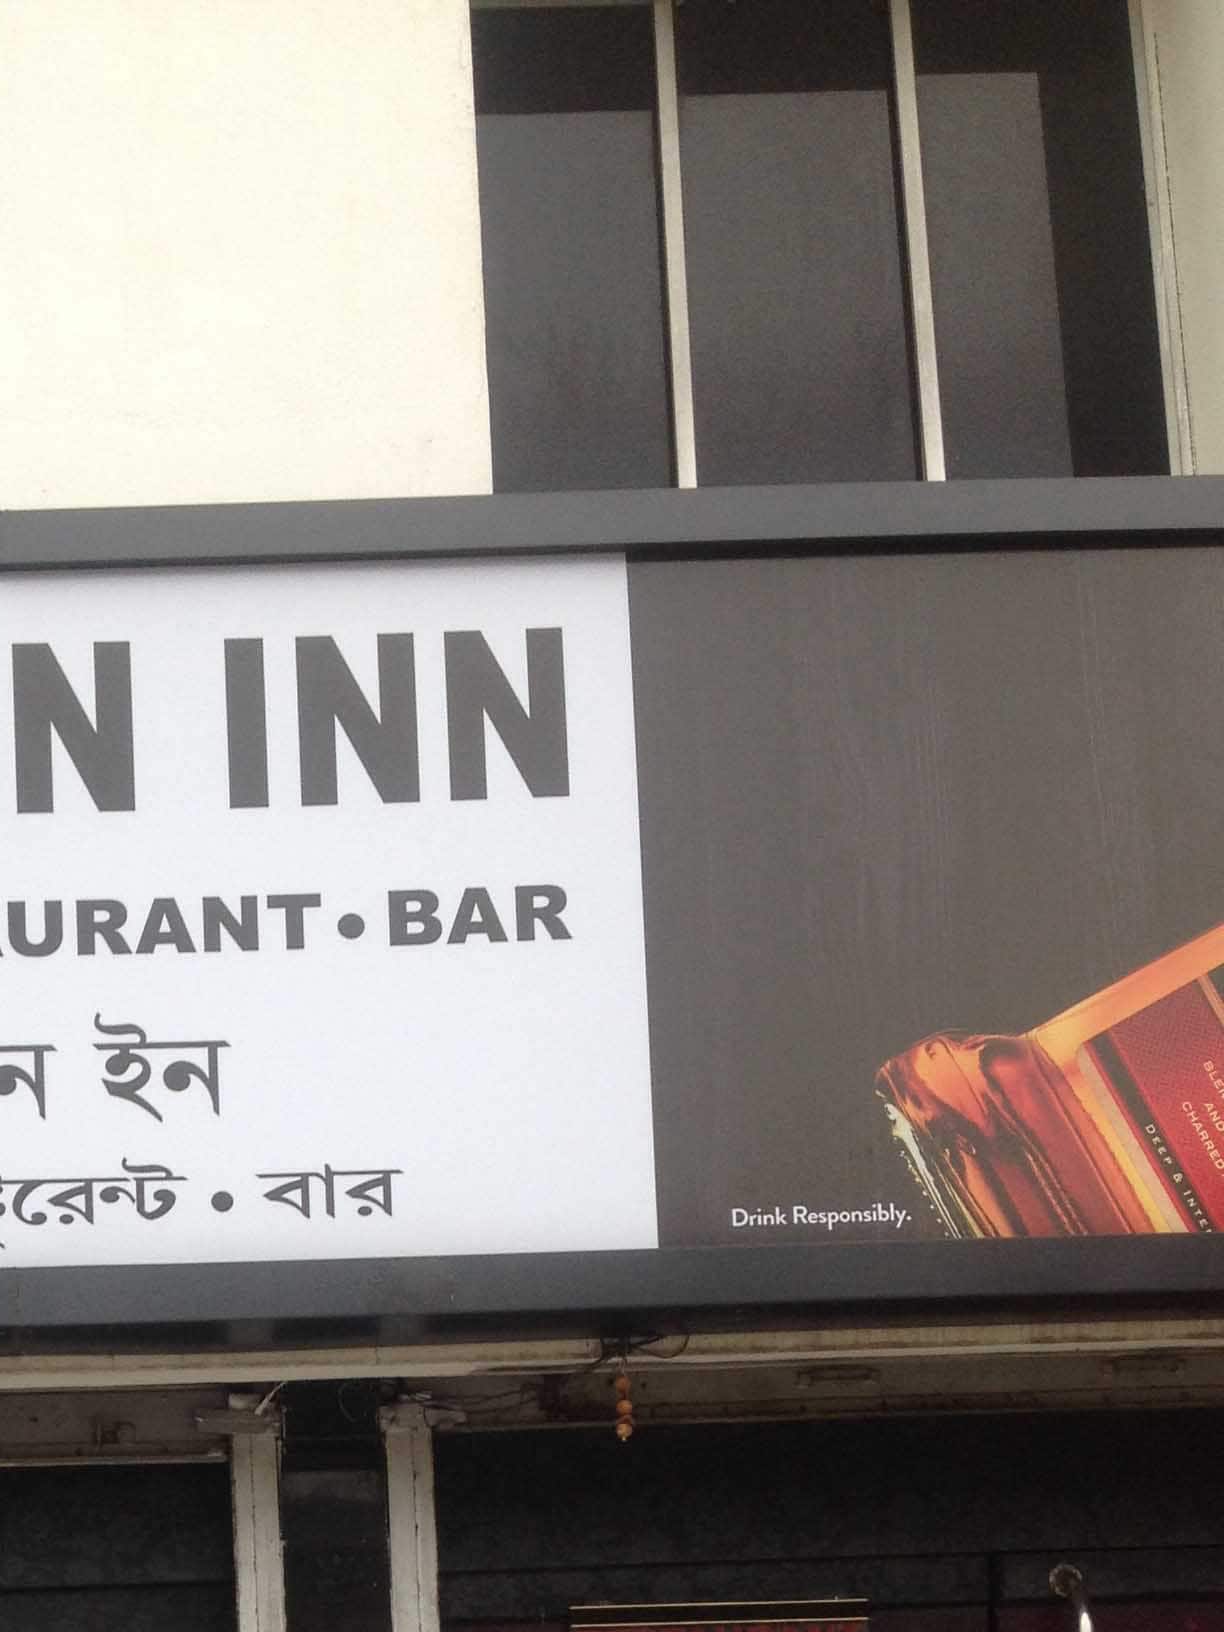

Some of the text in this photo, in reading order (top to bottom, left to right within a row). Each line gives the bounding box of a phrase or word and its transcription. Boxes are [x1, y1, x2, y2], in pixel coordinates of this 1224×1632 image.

[223, 627, 571, 809] INN
[387, 884, 573, 947] BAR
[93, 1012, 231, 1122] ইন
[255, 1162, 404, 1218] বার
[731, 1202, 913, 1231] Drink Responsibly.
